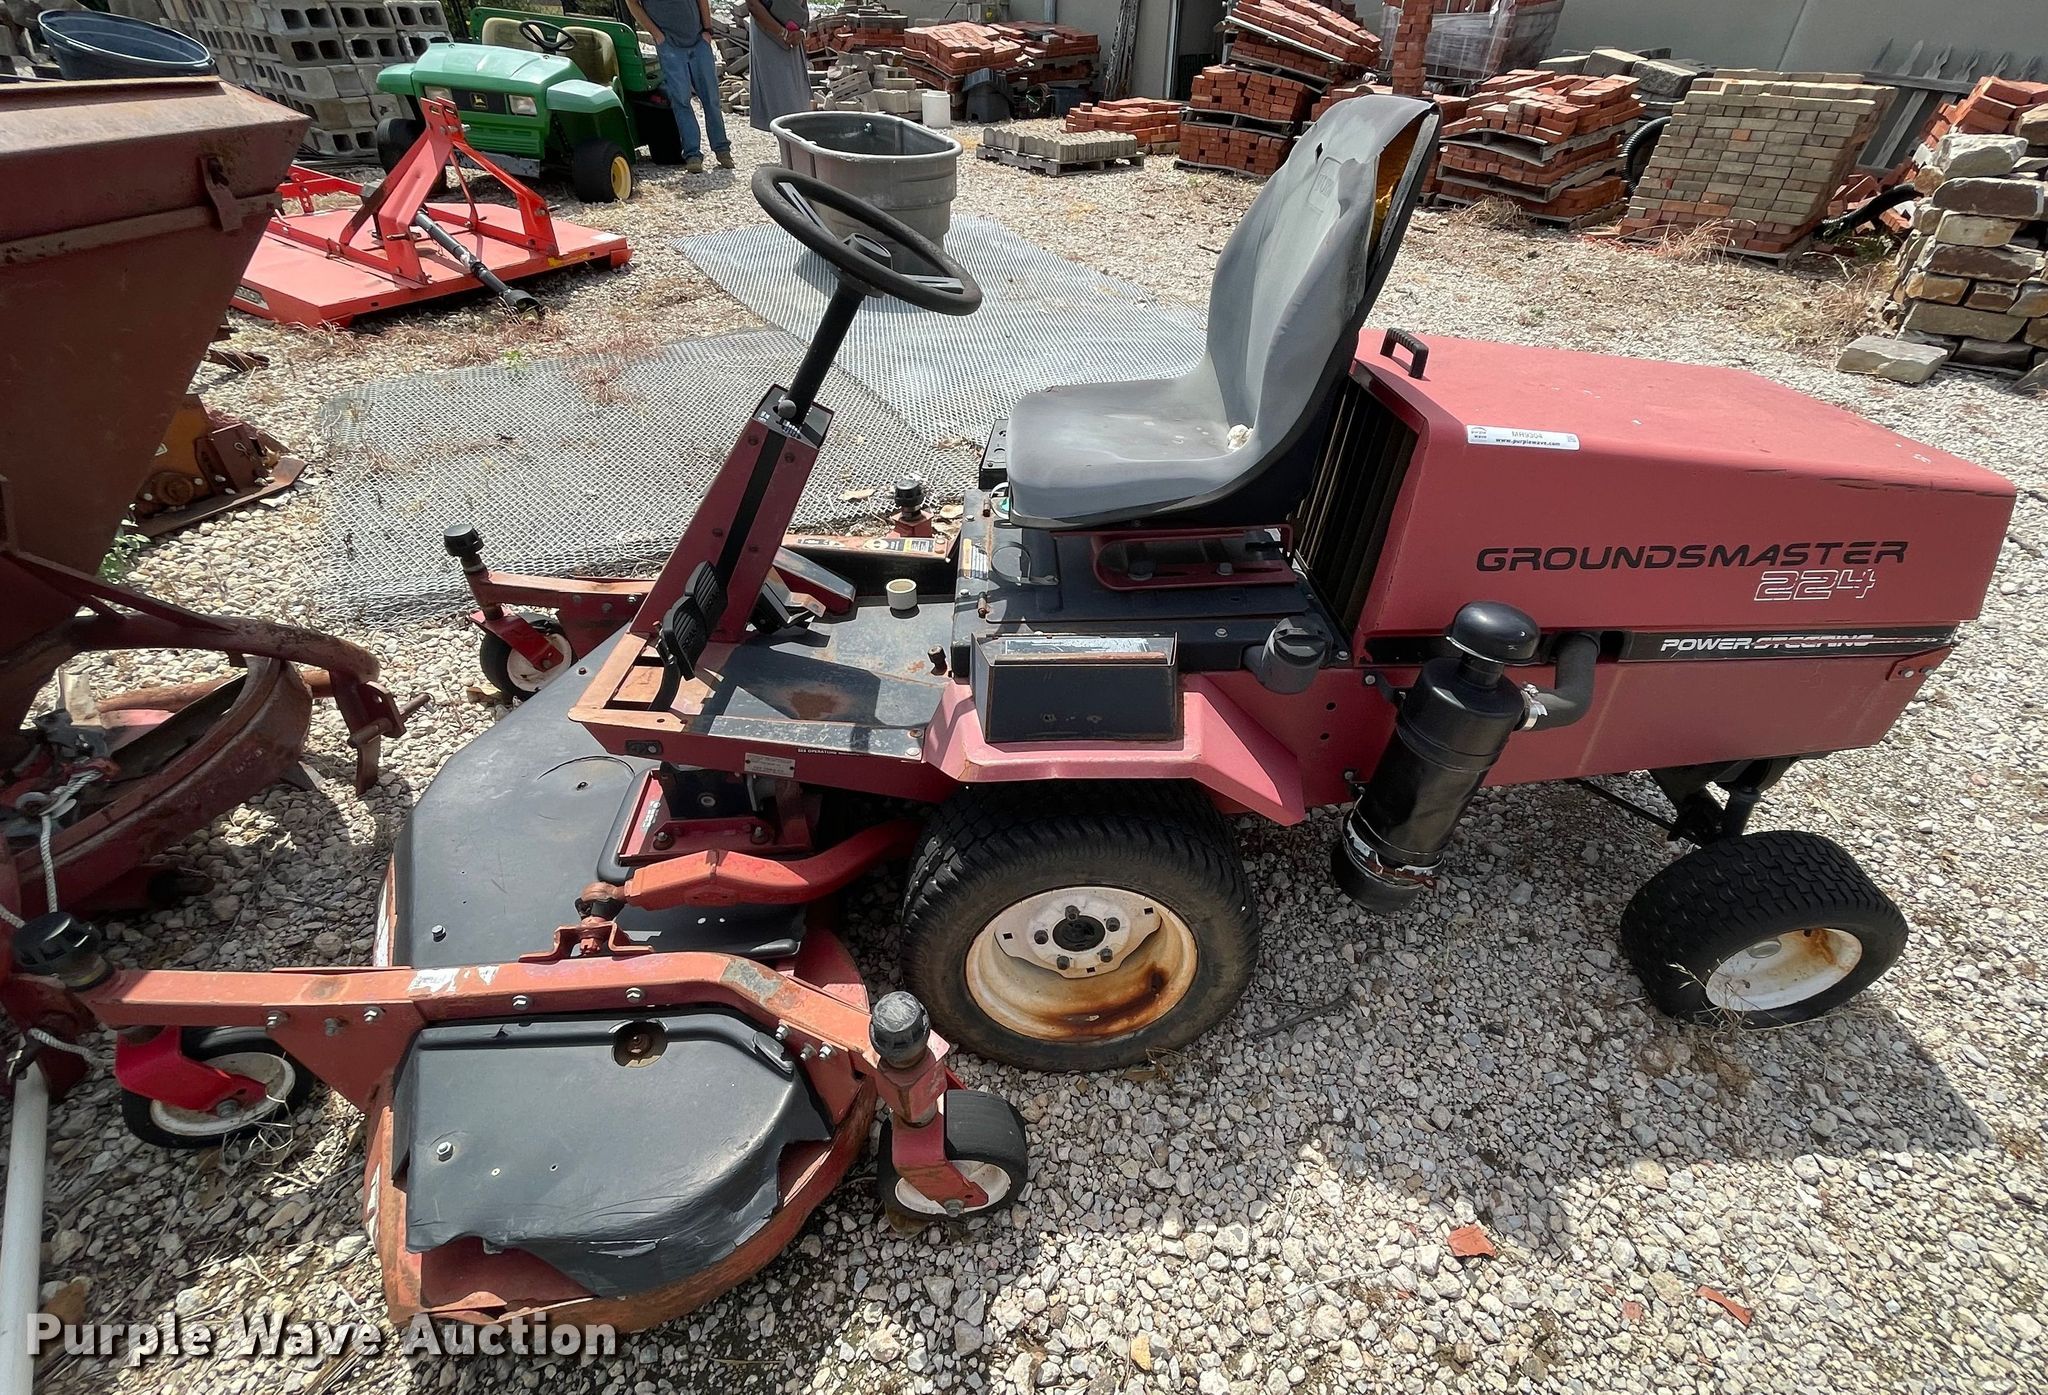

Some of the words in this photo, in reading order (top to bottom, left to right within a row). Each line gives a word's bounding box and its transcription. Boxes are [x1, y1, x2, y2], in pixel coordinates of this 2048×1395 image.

[1495, 438, 1561, 447] www.purplewave.com
[1476, 541, 1908, 572] GROUNDSMASTER
[1753, 567, 1877, 601] 224
[1661, 637, 1752, 651] POWER
